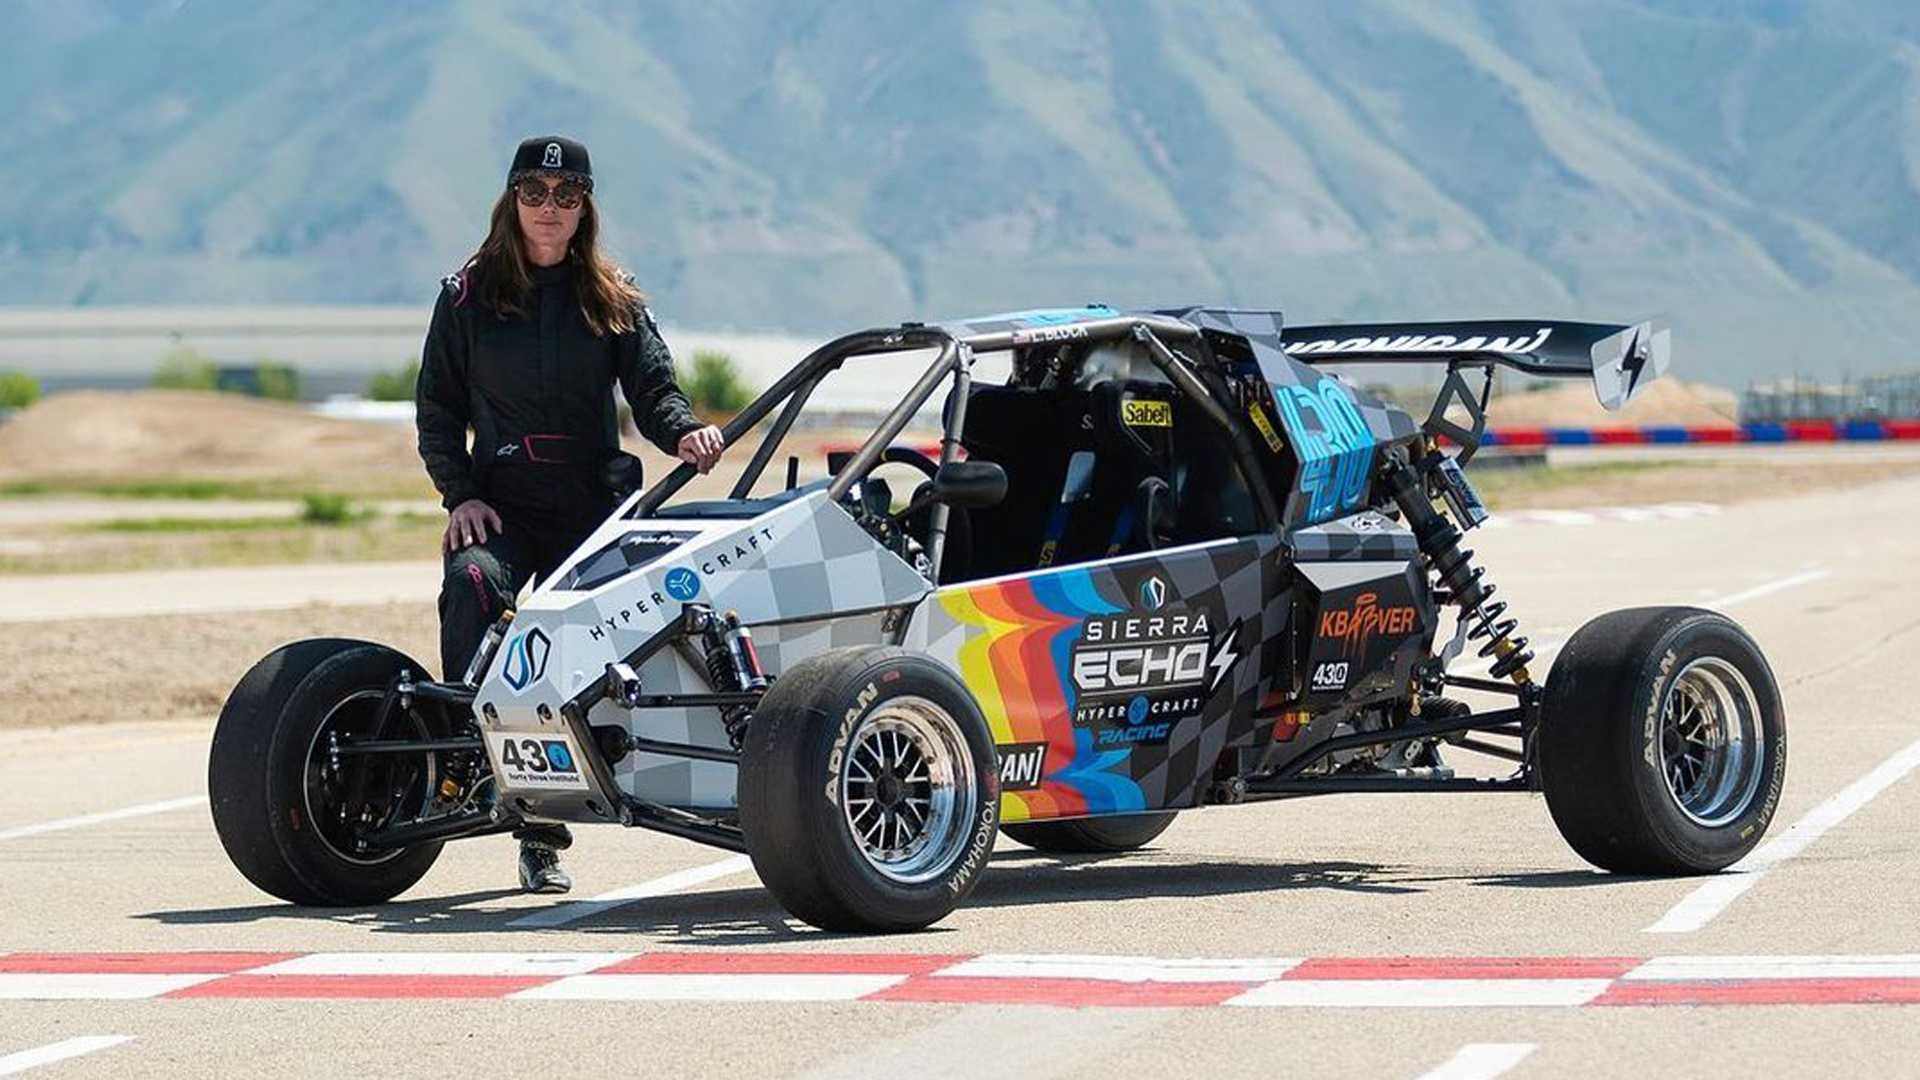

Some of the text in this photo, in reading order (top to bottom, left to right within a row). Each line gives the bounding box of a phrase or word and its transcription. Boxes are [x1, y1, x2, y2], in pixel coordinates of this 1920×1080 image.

[589, 528, 775, 641] HYPER CRAFT
[1086, 614, 1209, 642] SIERRA
[1073, 642, 1209, 690] ECHO
[1076, 698, 1200, 722] HYPER CRAFT
[825, 682, 879, 805] ADVAN
[1099, 722, 1170, 744] RACING
[998, 745, 1044, 787] AN]
[947, 799, 997, 893] YOKOHAMA
